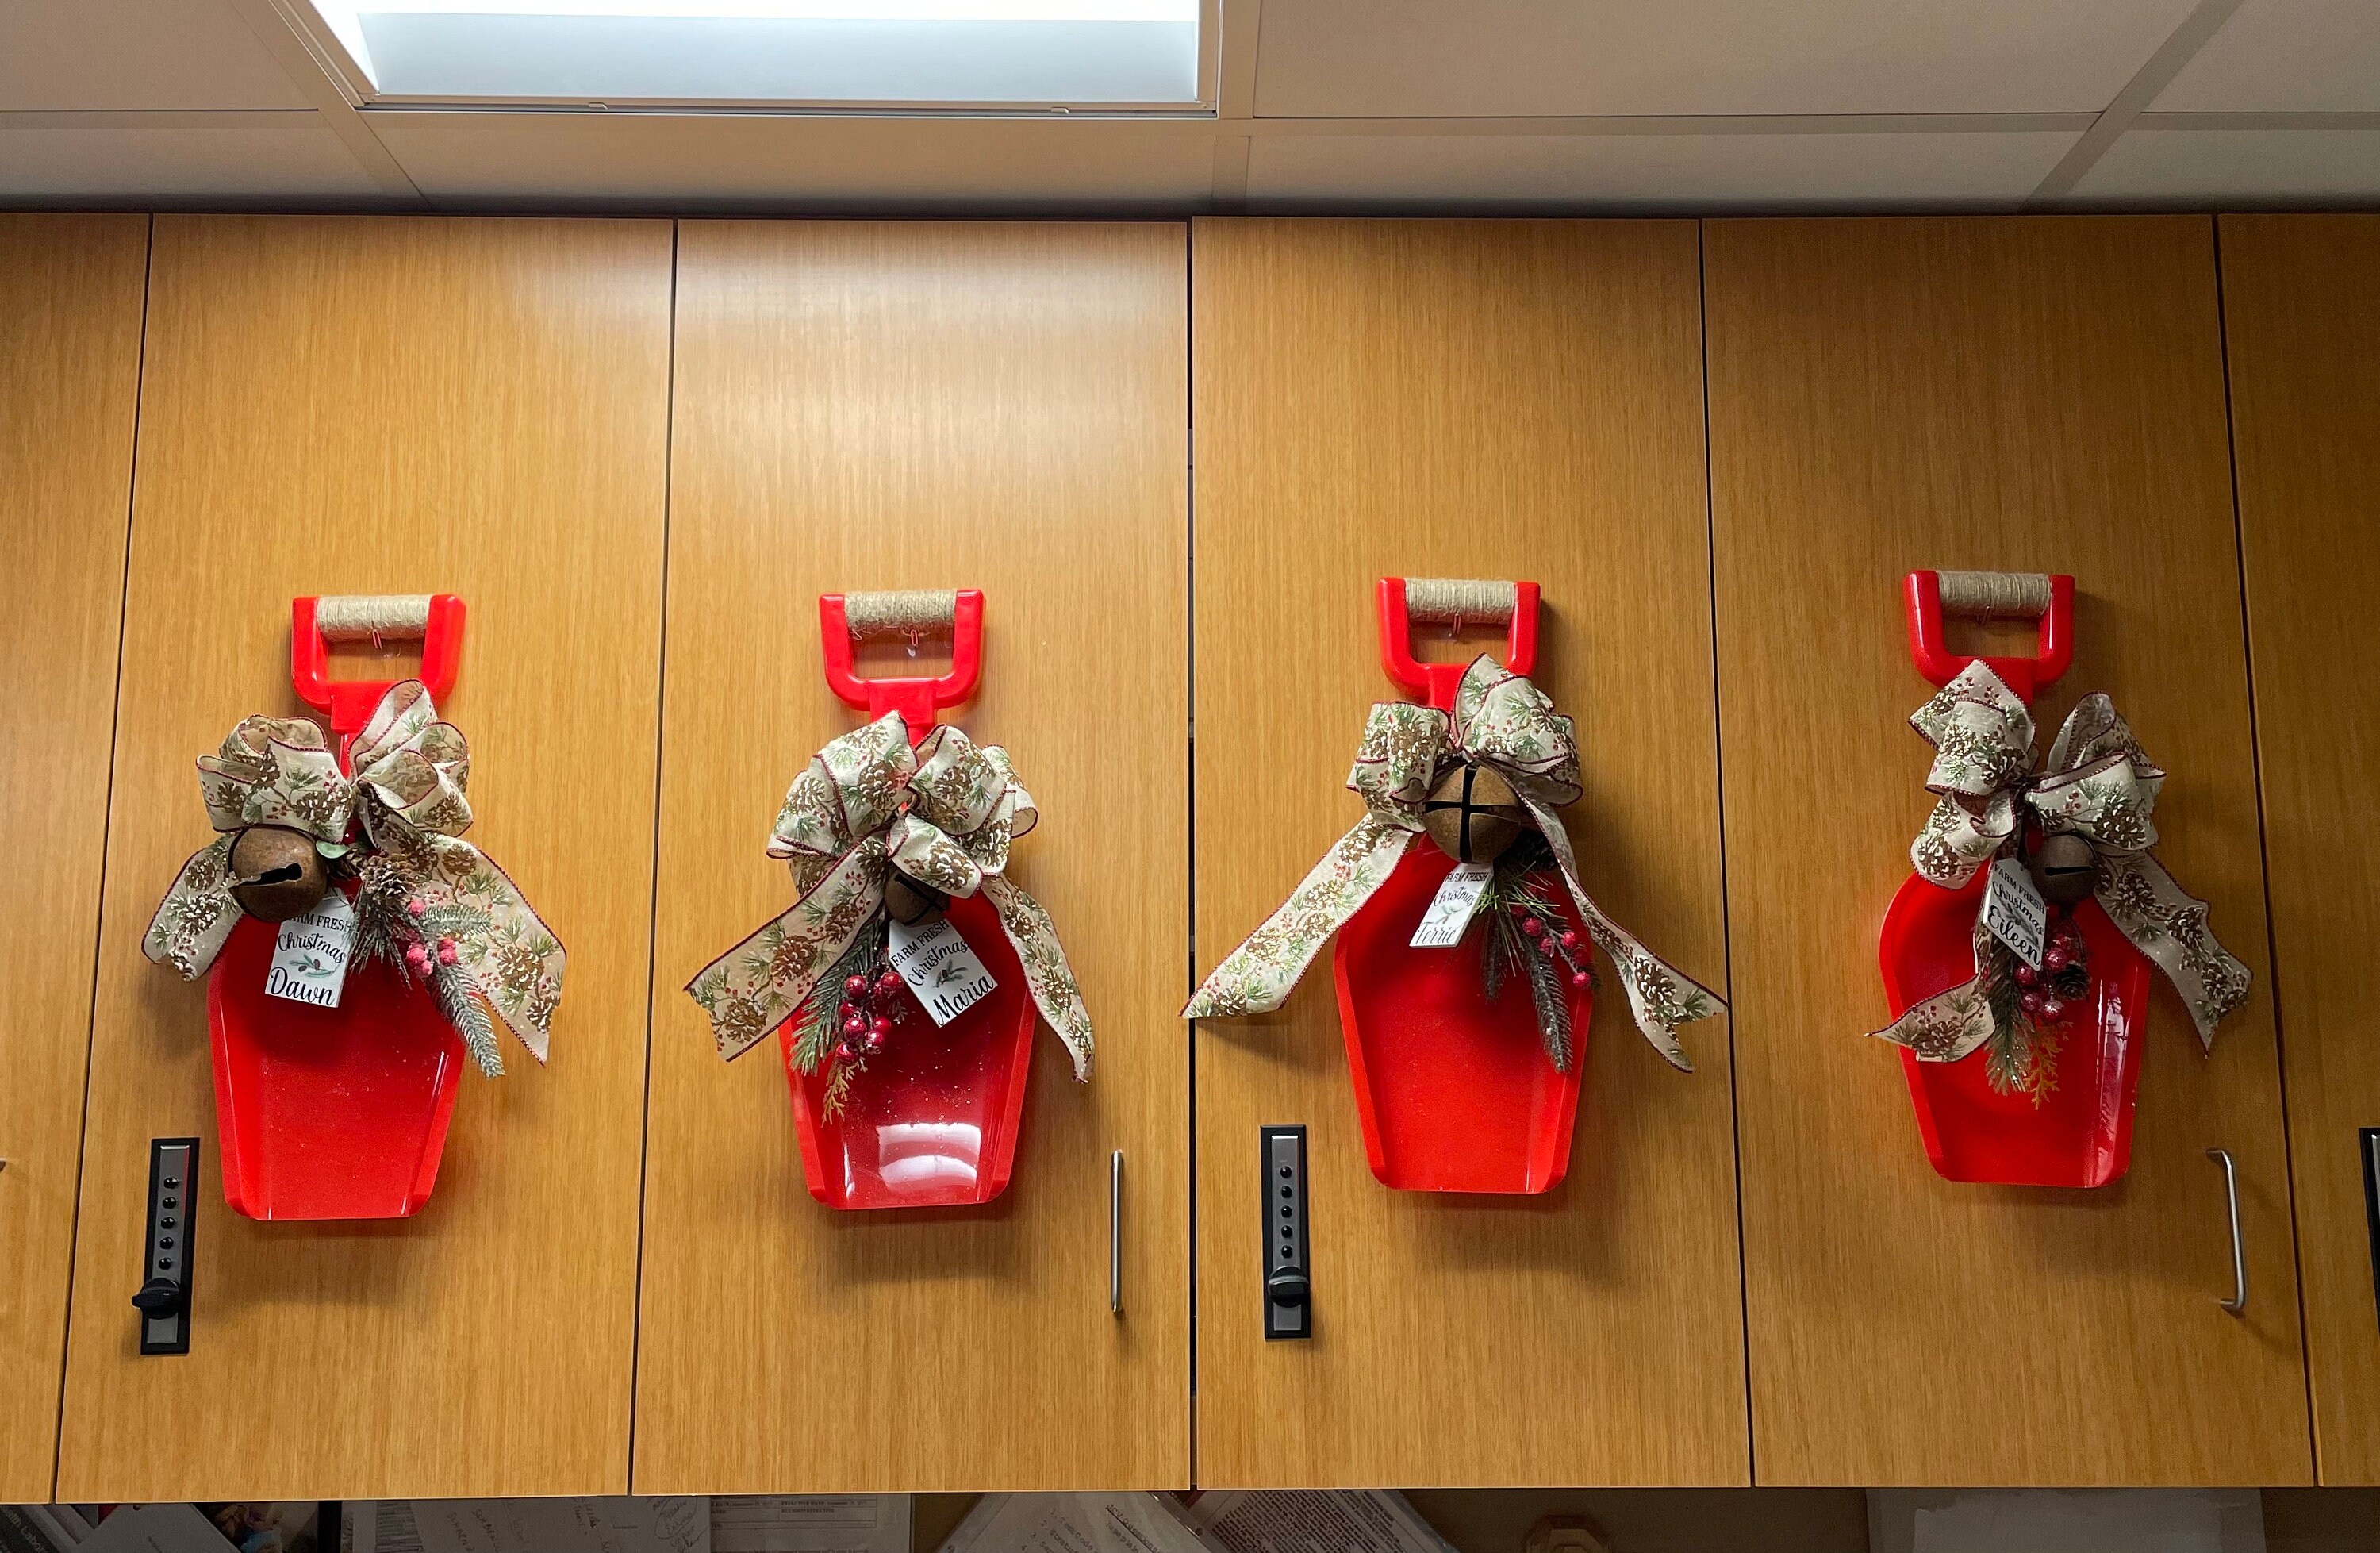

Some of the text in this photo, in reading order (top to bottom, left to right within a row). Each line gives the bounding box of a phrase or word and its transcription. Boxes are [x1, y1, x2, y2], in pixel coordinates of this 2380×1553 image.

[1434, 886, 1476, 907] Christmas
[1444, 872, 1489, 882] FARM FRESH
[1994, 863, 2044, 914] FARM FRESH
[1992, 881, 2044, 935] Christmas
[278, 932, 346, 963] Christmas
[891, 919, 950, 967] FARM FRESH
[1988, 905, 2040, 965] Eileen
[270, 967, 335, 1005] Dawn
[908, 940, 968, 986] Christmas
[933, 976, 994, 1026] Maria
